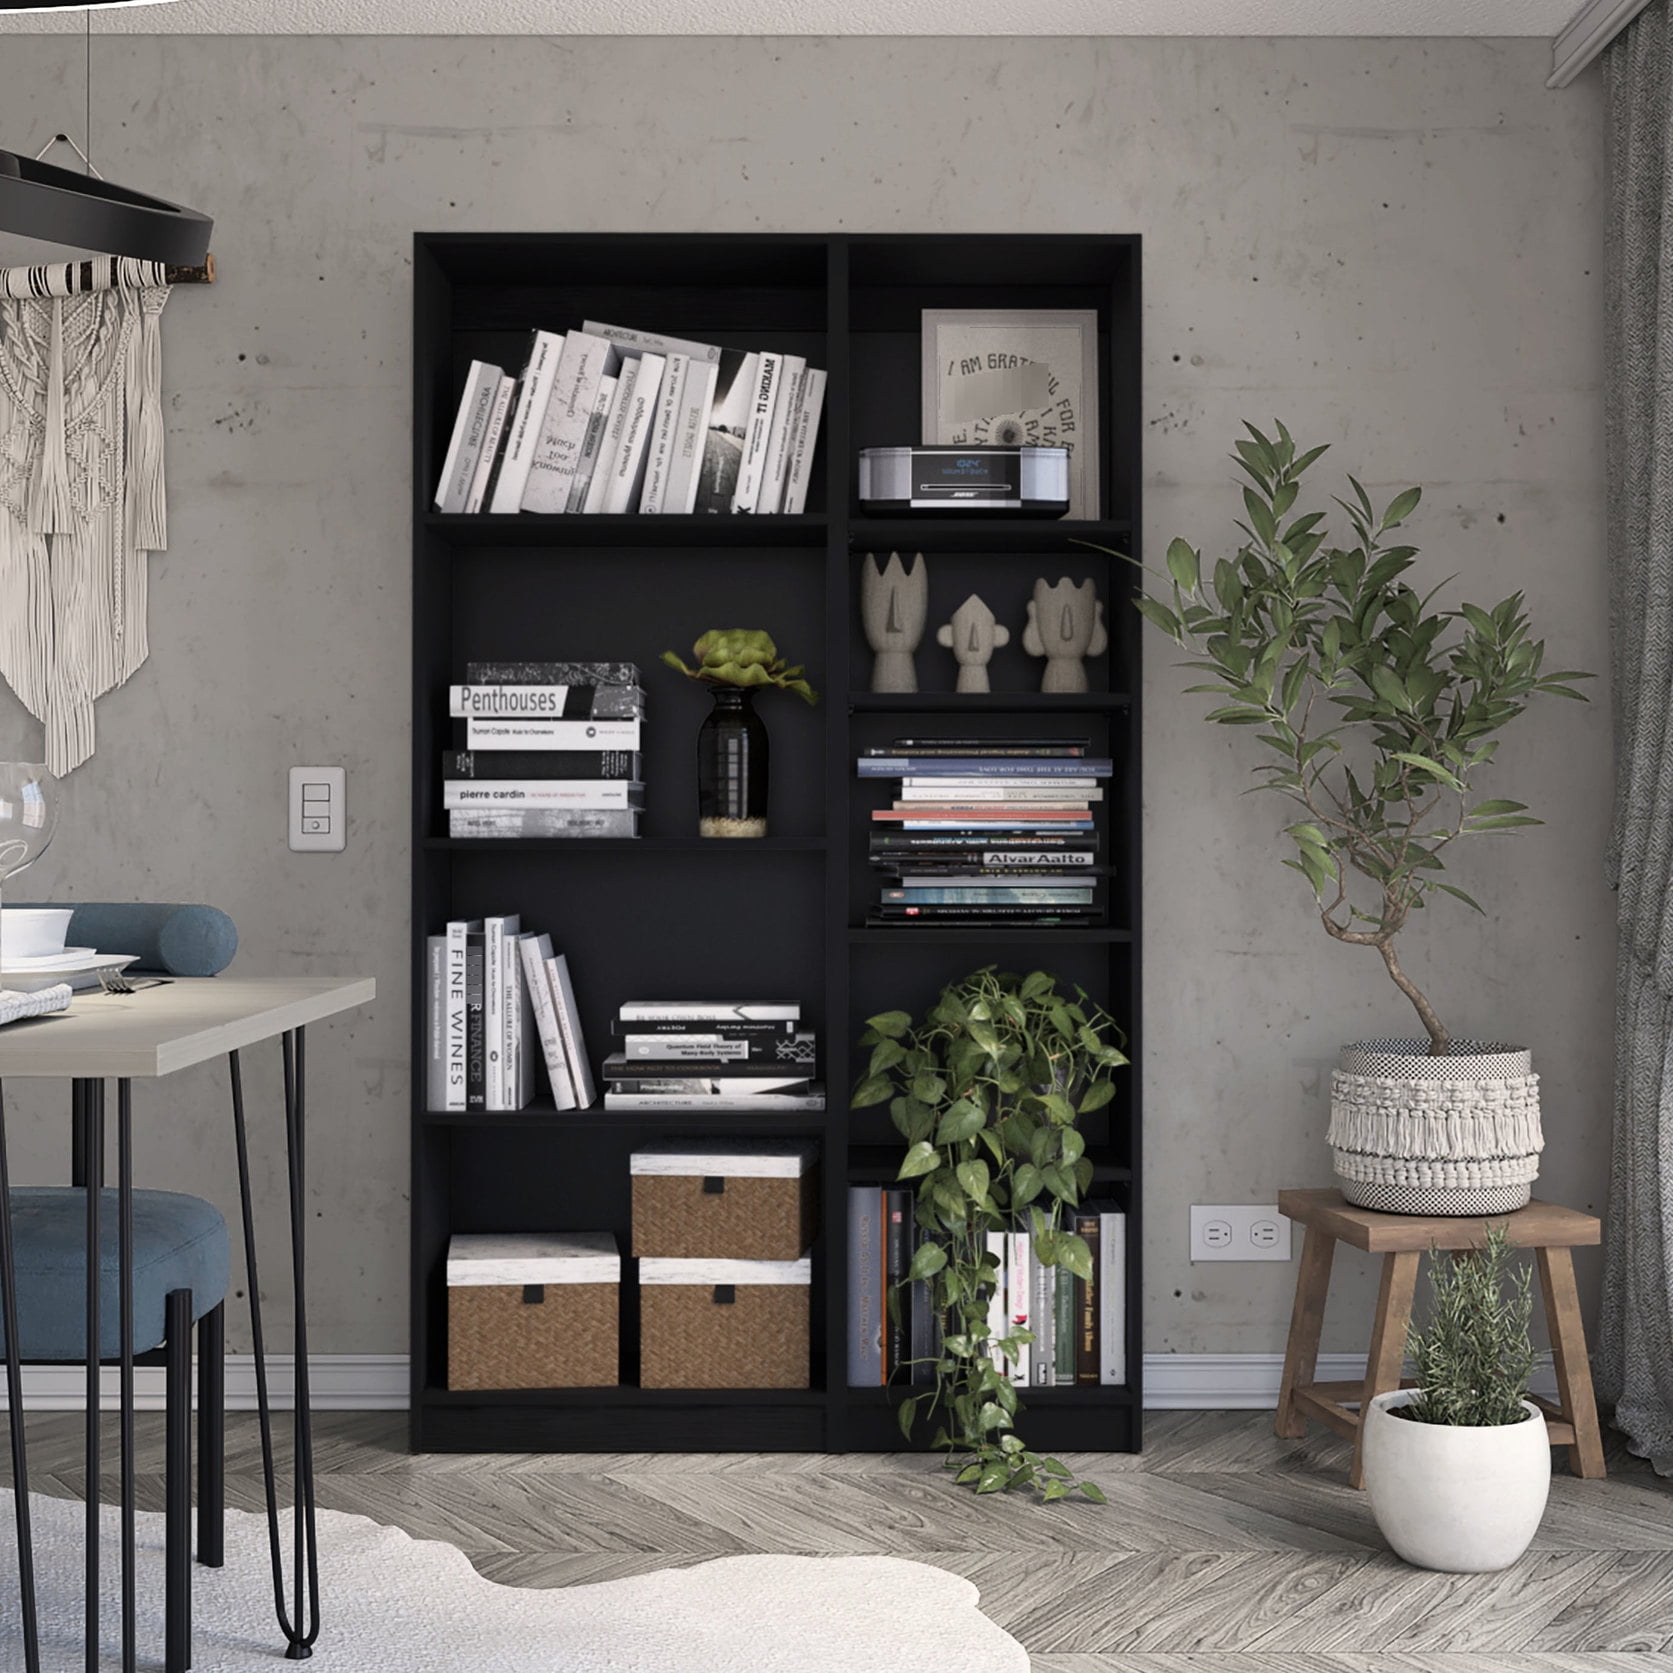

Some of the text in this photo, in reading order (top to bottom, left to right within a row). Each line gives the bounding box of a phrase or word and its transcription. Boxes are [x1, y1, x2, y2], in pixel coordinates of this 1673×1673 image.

[960, 356, 982, 376] AM
[1057, 398, 1076, 433] FOR
[483, 436, 496, 463] BEAUTY
[461, 687, 556, 714] Penthouses
[459, 788, 525, 801] pierre cardin
[989, 854, 1086, 863] Alvar Aalto
[451, 950, 463, 998] FINE
[451, 1011, 463, 1085] WINES
[470, 1016, 482, 1082] FINANCE
[507, 1030, 512, 1041] OF
[1016, 1292, 1026, 1310] Design
